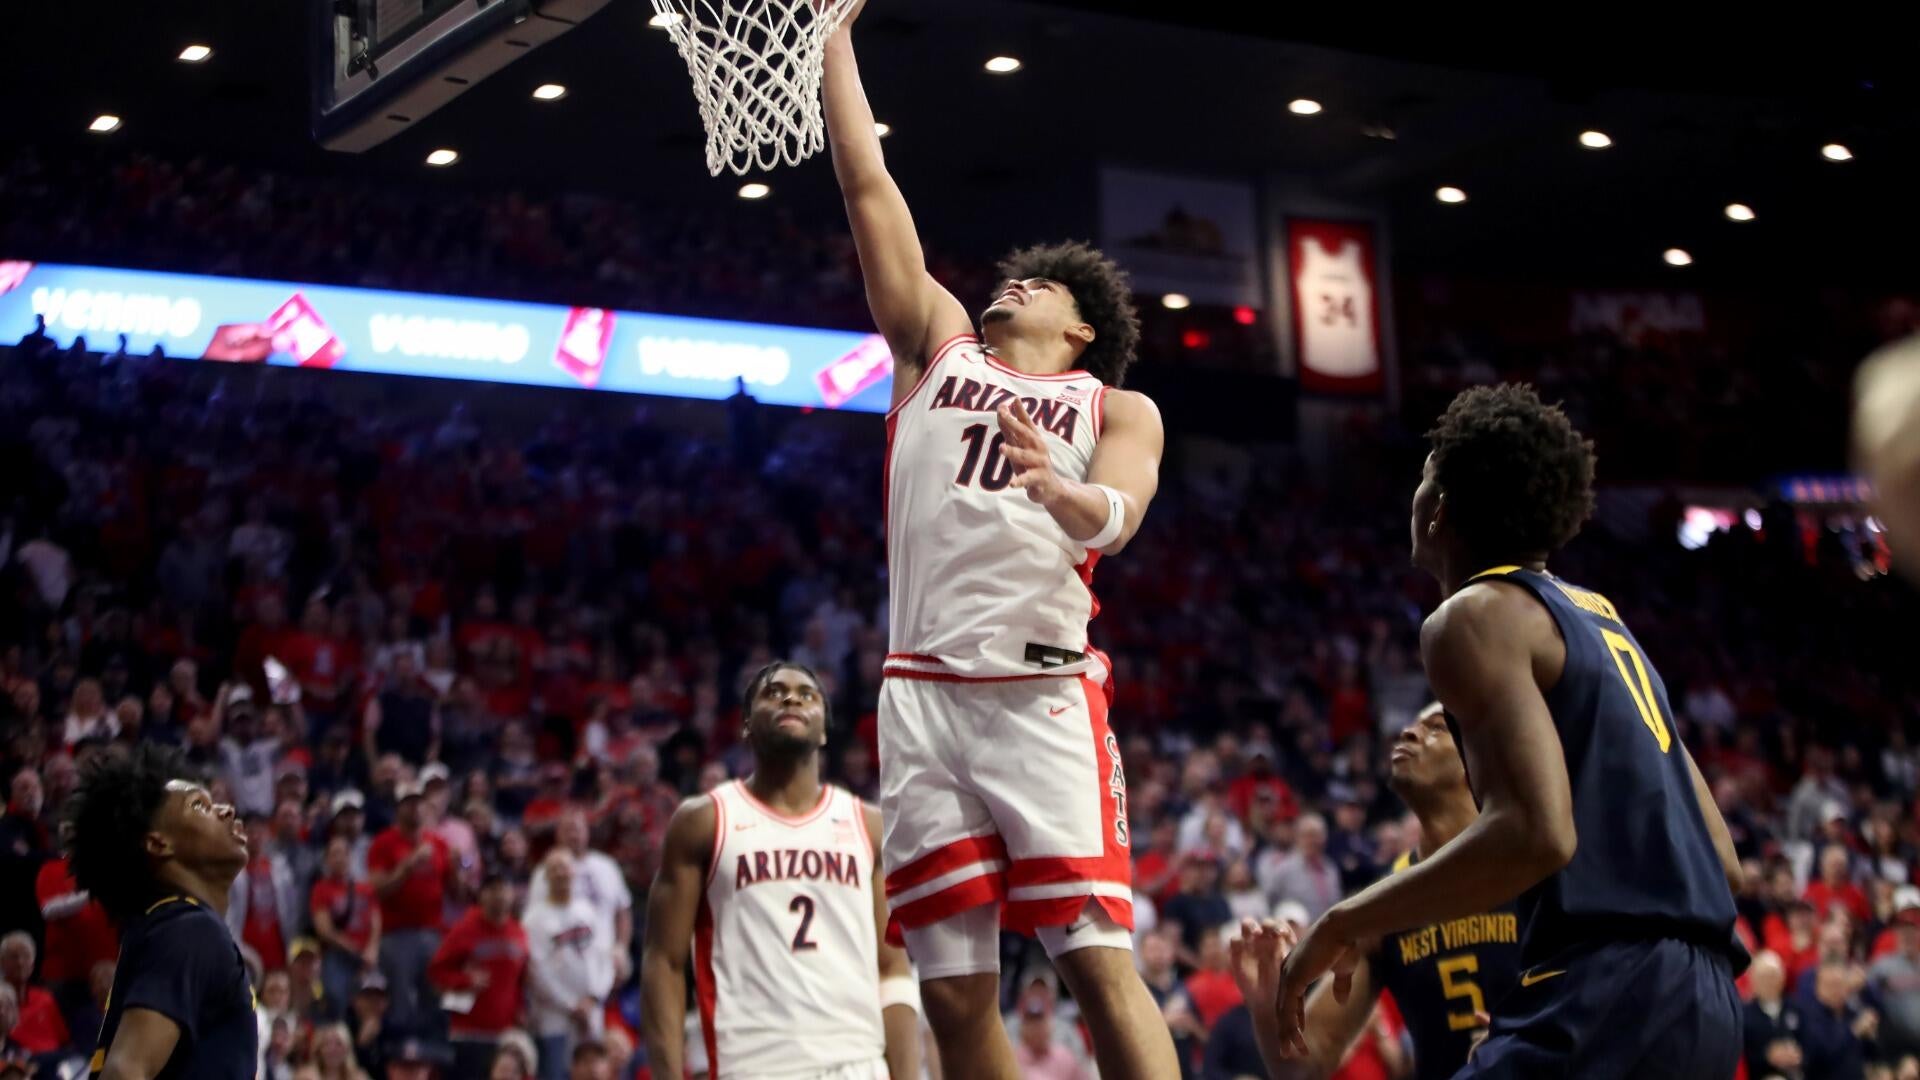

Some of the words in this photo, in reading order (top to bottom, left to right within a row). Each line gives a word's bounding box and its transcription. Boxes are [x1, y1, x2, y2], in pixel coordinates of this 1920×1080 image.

[929, 375, 1079, 446] ARIZONA
[955, 423, 1014, 492] 10
[1600, 627, 1672, 754] 0
[1104, 735, 1129, 847] CATS
[735, 849, 861, 891] ARIZONA
[789, 893, 818, 953] 2
[1398, 924, 1439, 966] WEST
[1439, 912, 1518, 950] VIRGINIA
[1437, 954, 1487, 1032] 5
